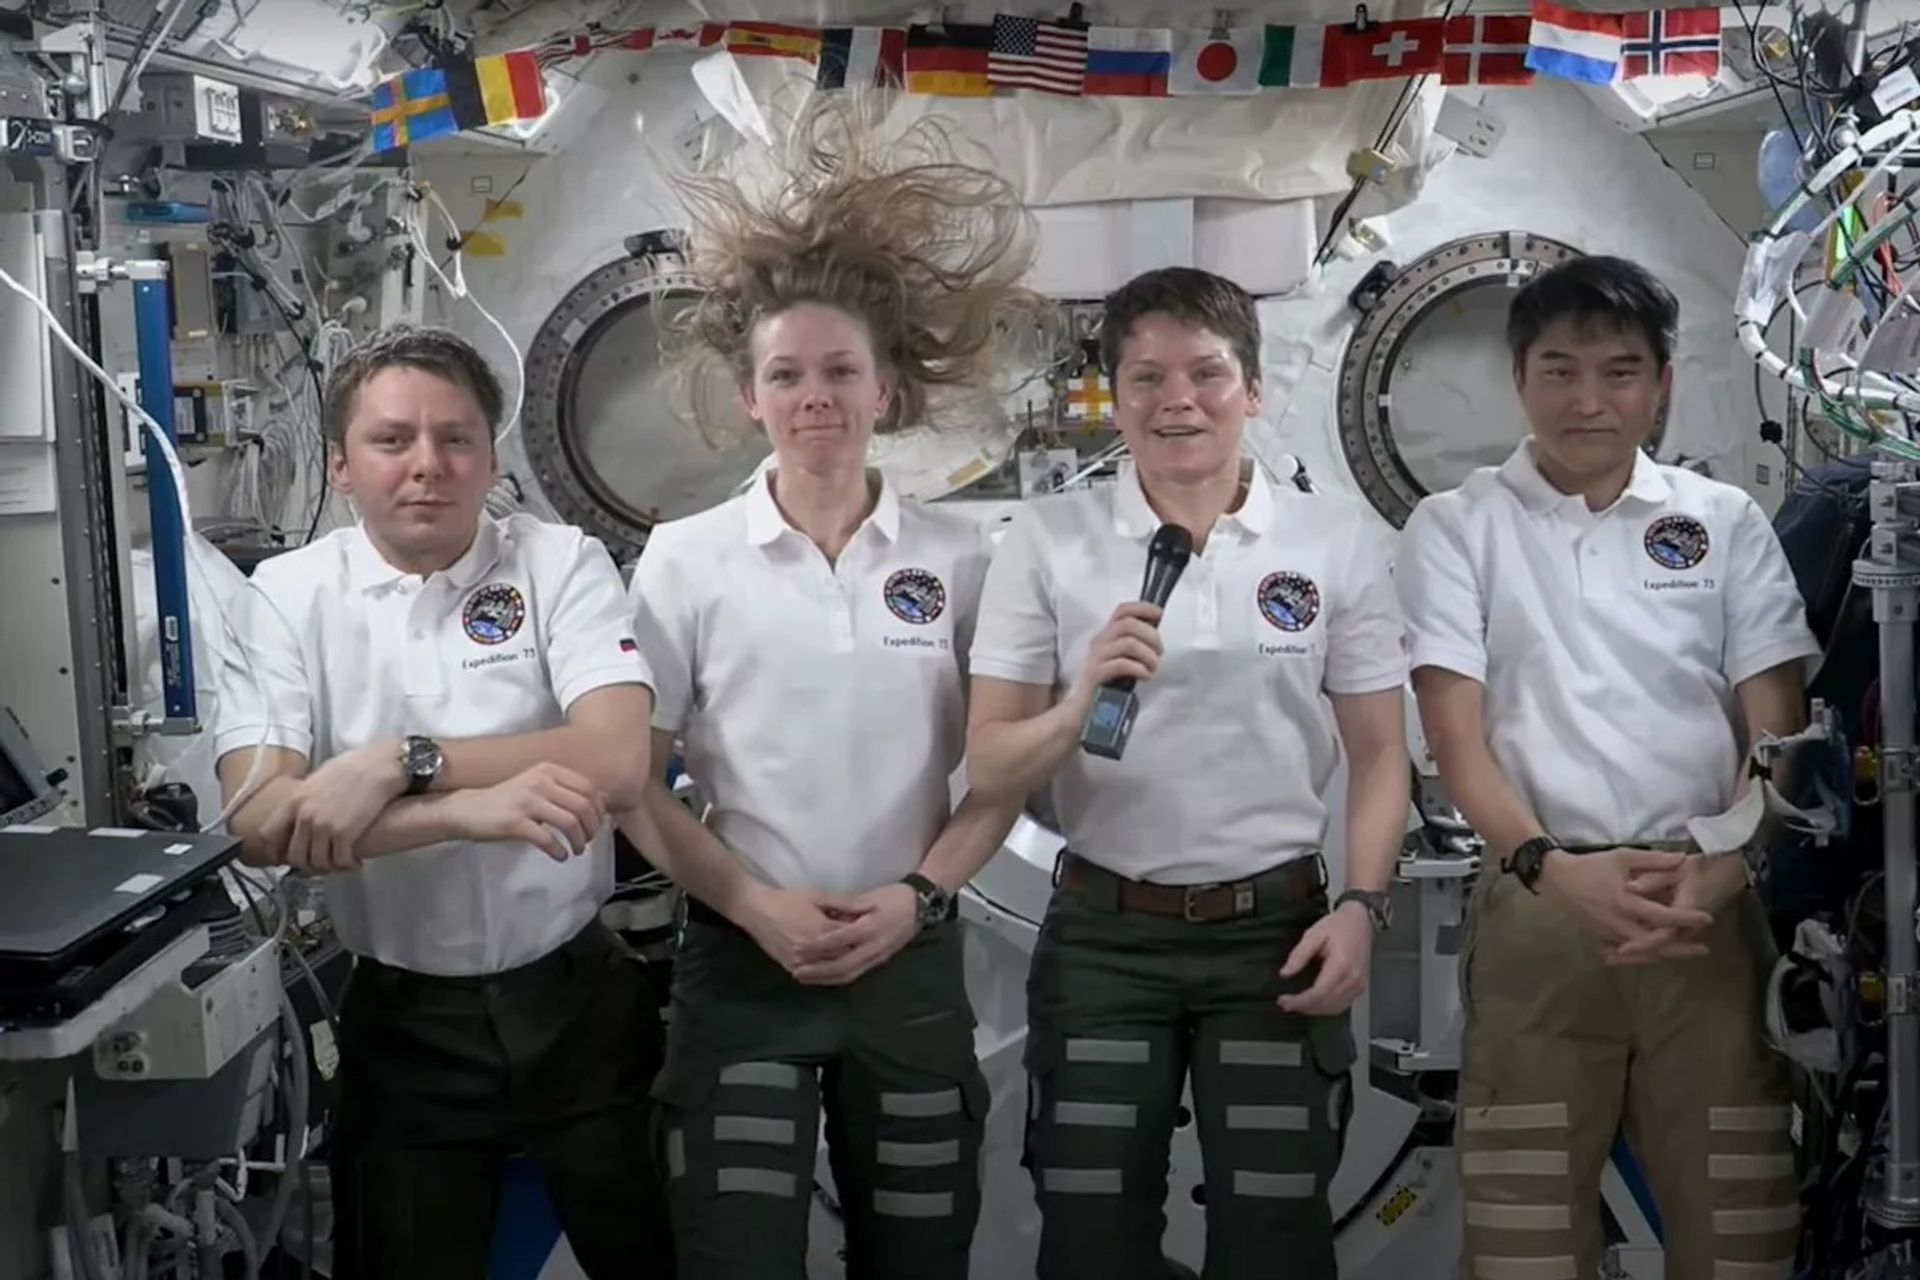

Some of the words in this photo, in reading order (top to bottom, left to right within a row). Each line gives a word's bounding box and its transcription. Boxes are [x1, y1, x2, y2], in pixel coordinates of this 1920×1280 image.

[1644, 579, 1698, 591] Expedition
[883, 636, 934, 648] Expedition
[1259, 643, 1307, 656] Expedition
[462, 653, 518, 669] Expedition
[523, 647, 536, 659] 73
